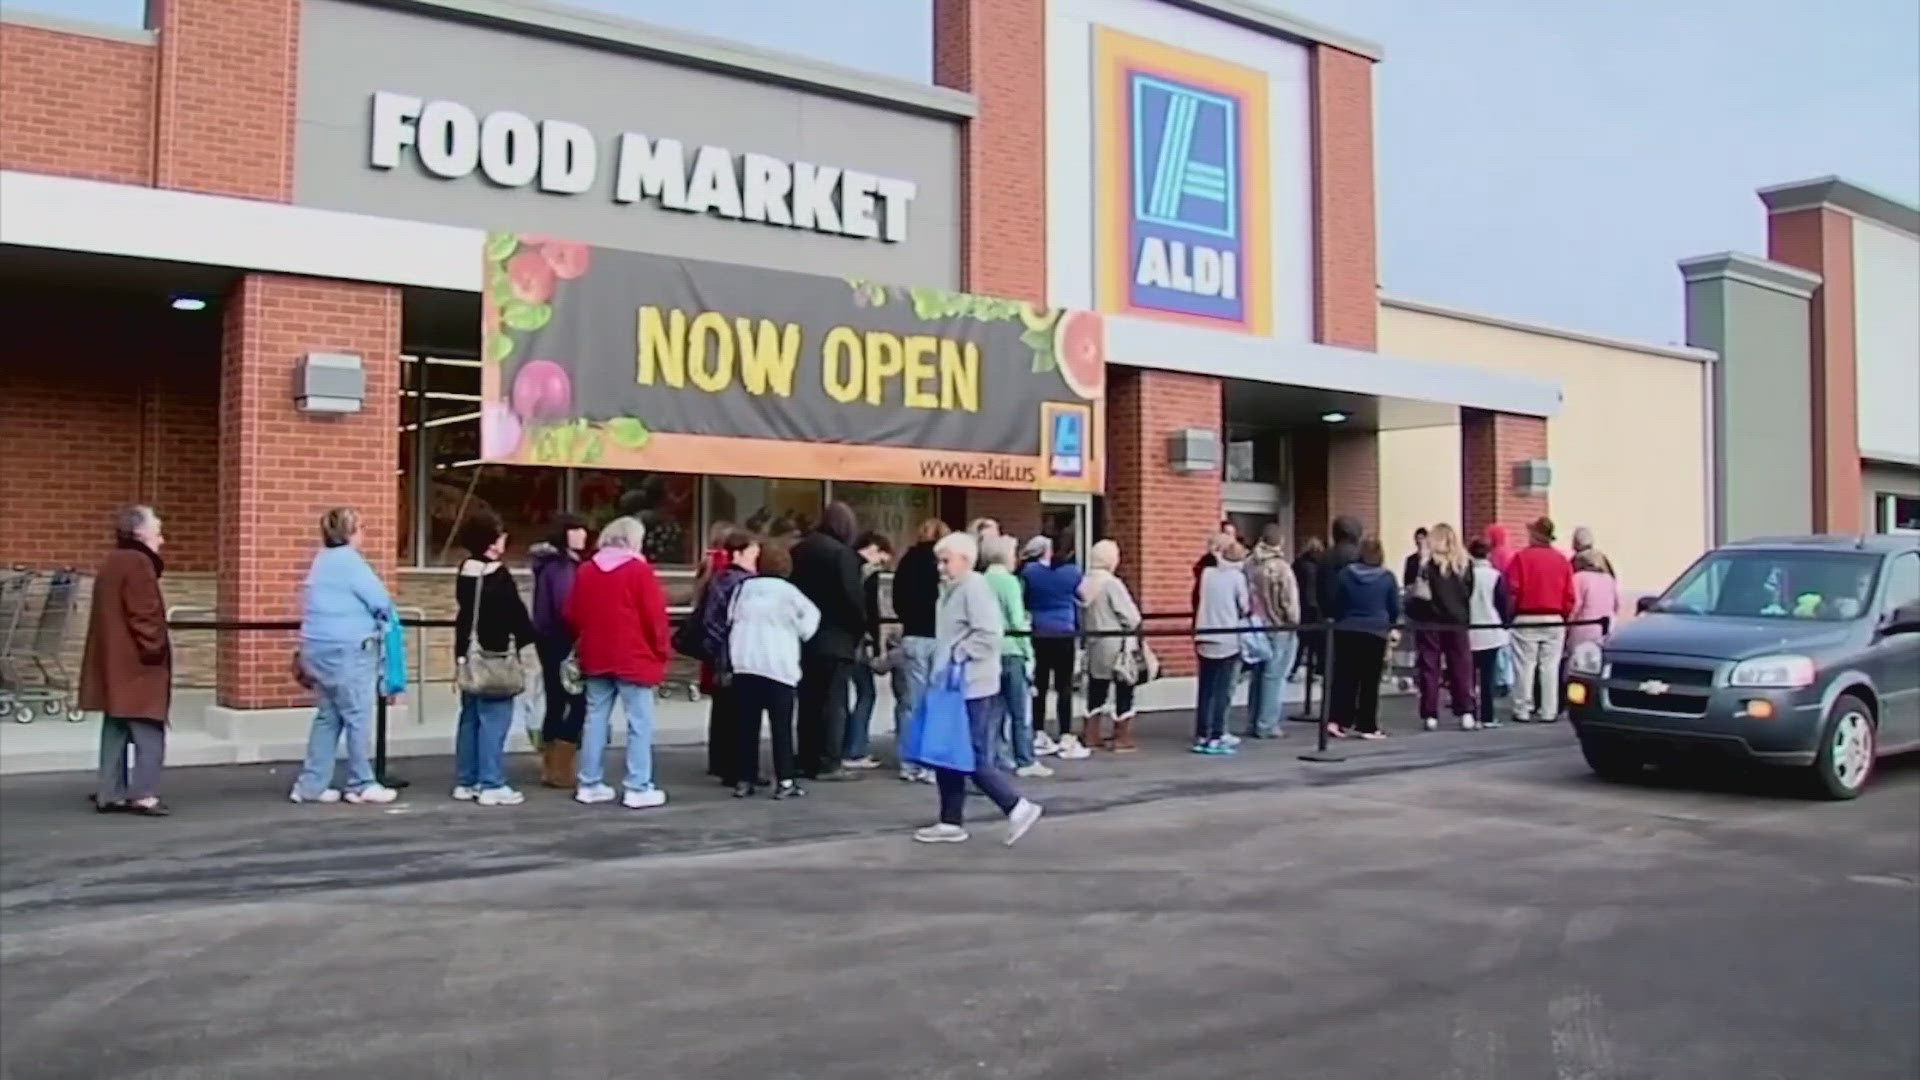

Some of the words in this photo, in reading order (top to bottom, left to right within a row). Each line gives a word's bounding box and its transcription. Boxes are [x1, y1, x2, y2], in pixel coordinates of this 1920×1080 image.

[371, 90, 597, 194] FOOD
[615, 131, 917, 242] MARKET
[1136, 236, 1236, 299] ALDI
[637, 306, 799, 397] NOW
[822, 326, 979, 412] OPEN
[920, 460, 1036, 483] www.aldi.us
